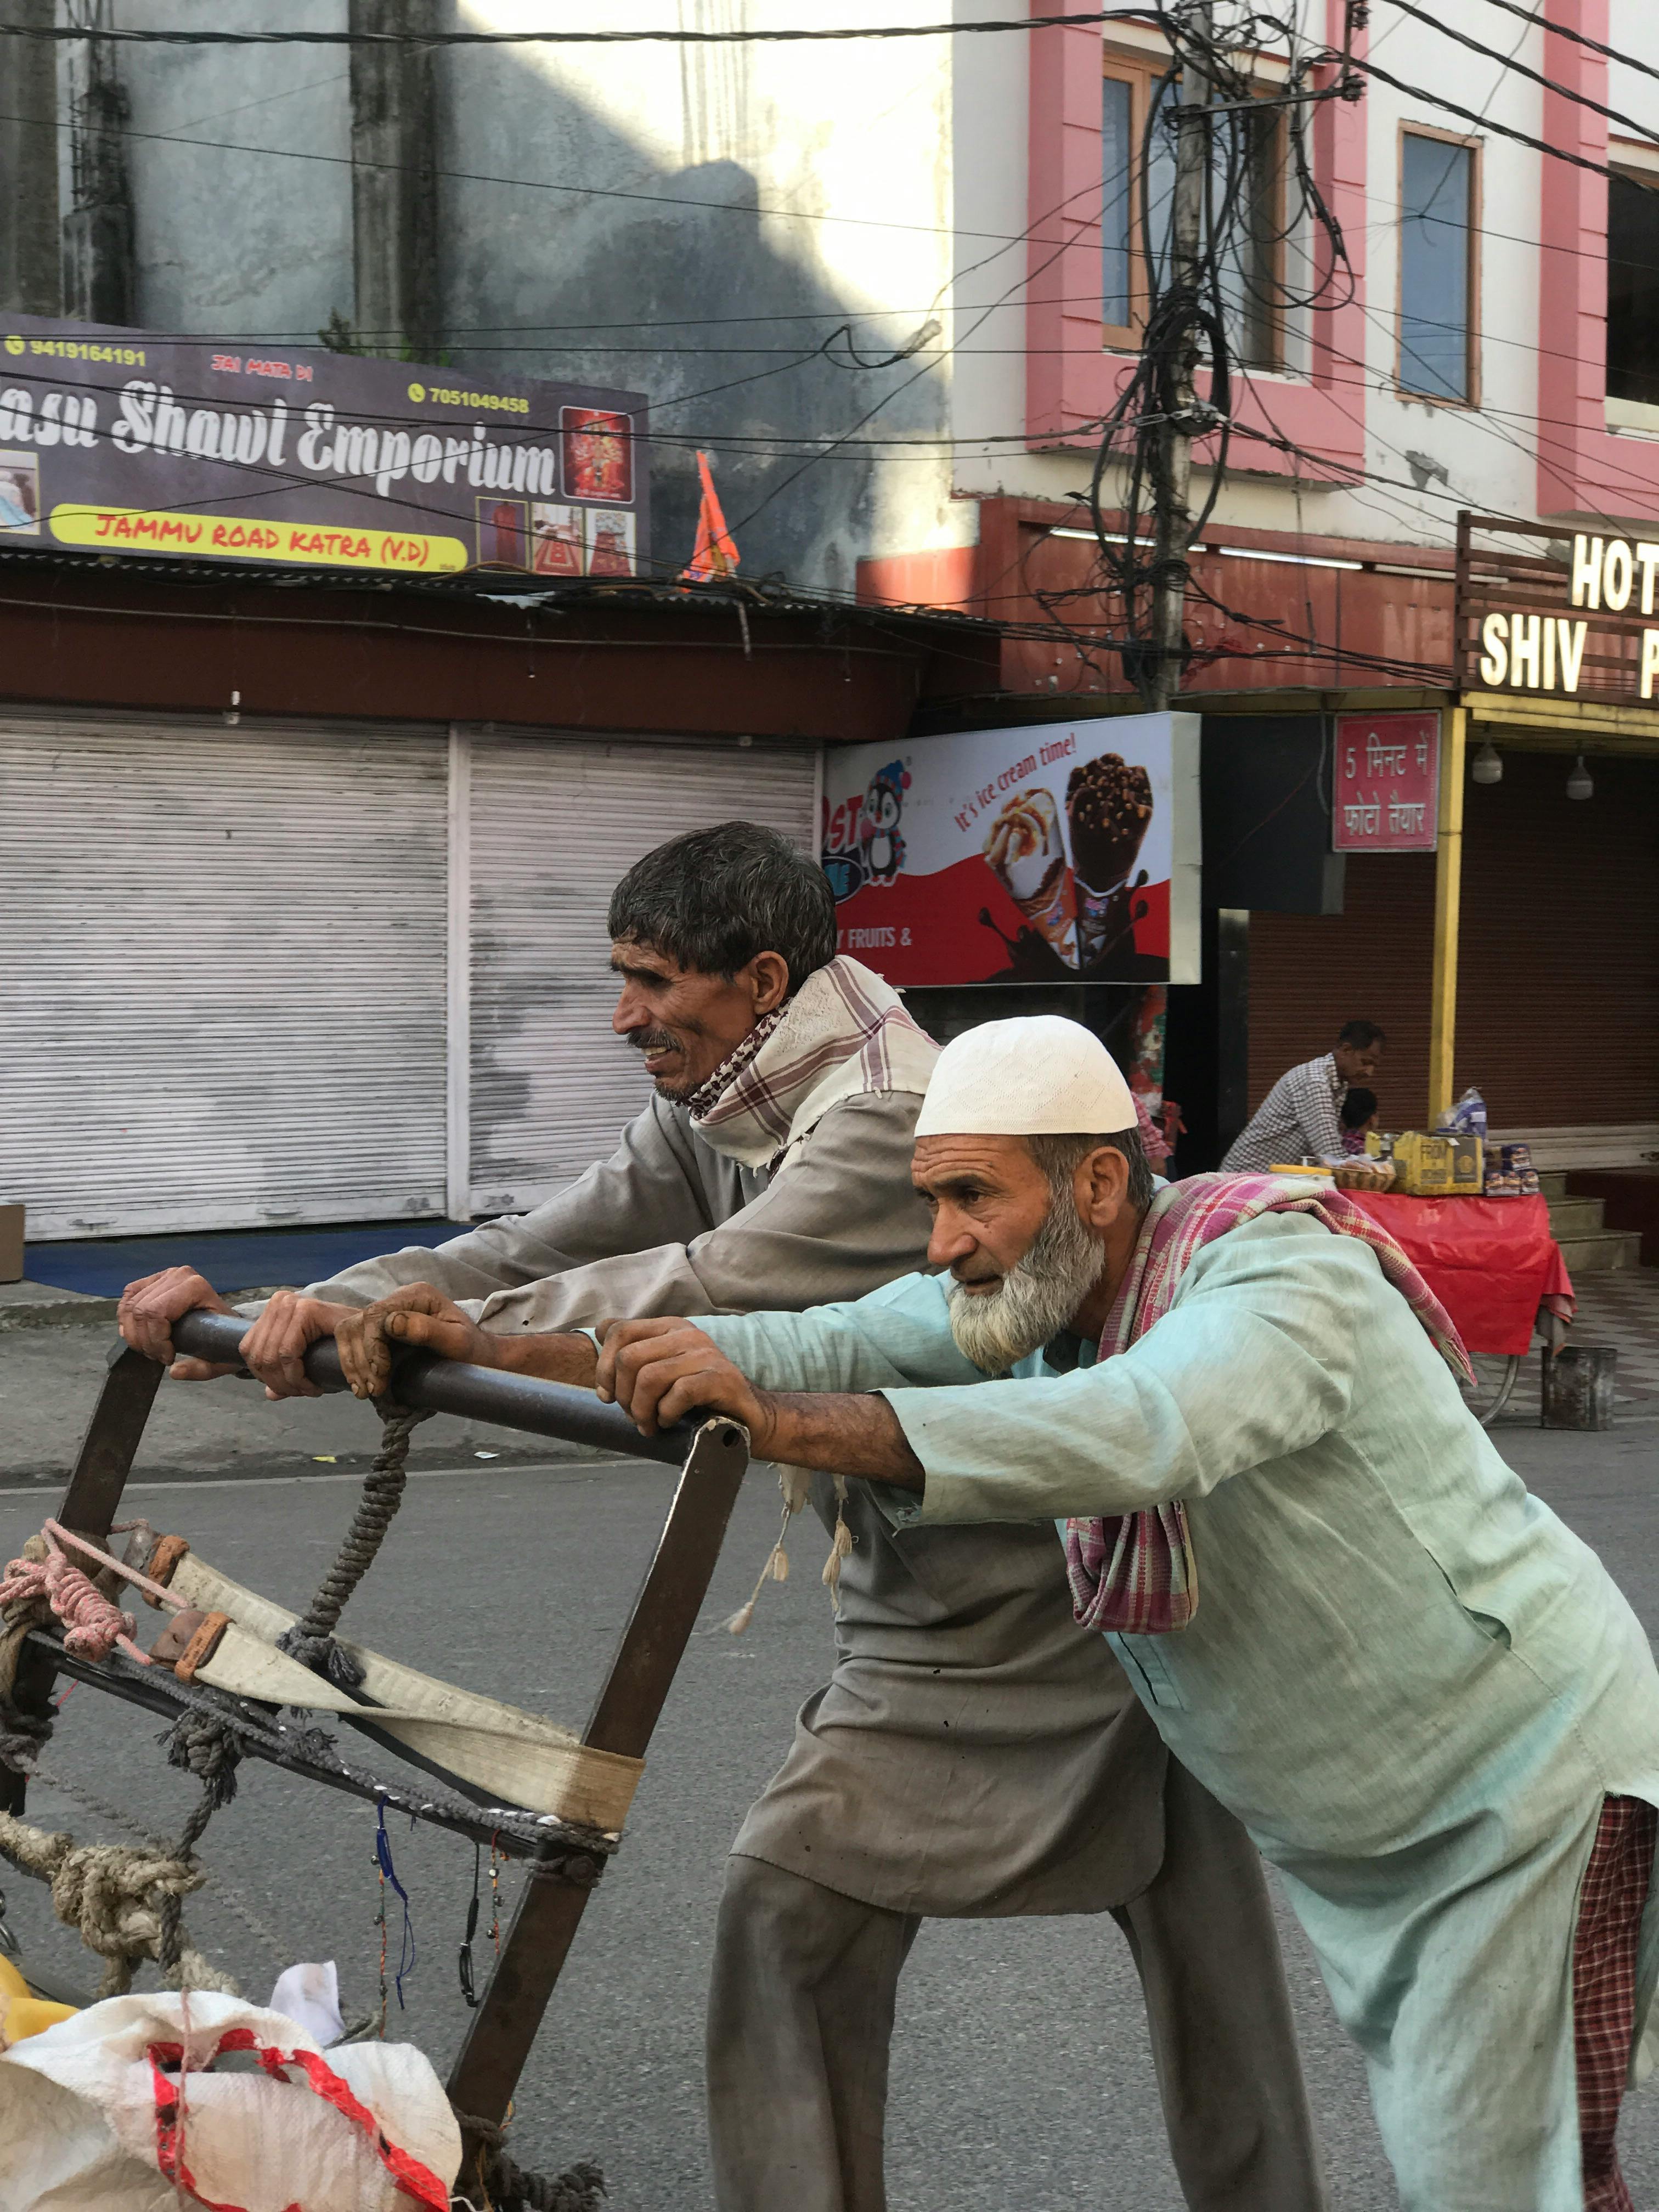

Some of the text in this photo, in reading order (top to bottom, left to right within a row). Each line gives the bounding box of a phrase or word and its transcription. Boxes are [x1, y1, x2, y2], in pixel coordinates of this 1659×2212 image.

[30, 340, 146, 366] 9419164191
[210, 354, 313, 382] JAI MATA DI
[430, 387, 529, 414] 7051049458
[111, 380, 287, 466] Shawl
[297, 402, 555, 497] Emporium
[95, 515, 202, 543] JAMMU
[212, 524, 280, 550] ROAD
[289, 531, 372, 558] KATRA
[1481, 613, 1588, 692] SHIV
[975, 783, 996, 809] ice
[997, 755, 1037, 791] cream
[1039, 732, 1077, 766] time!
[1345, 747, 1356, 778] 5
[1365, 732, 1407, 778] मिनट
[848, 926, 896, 949] FRUITS
[900, 927, 913, 946] &
